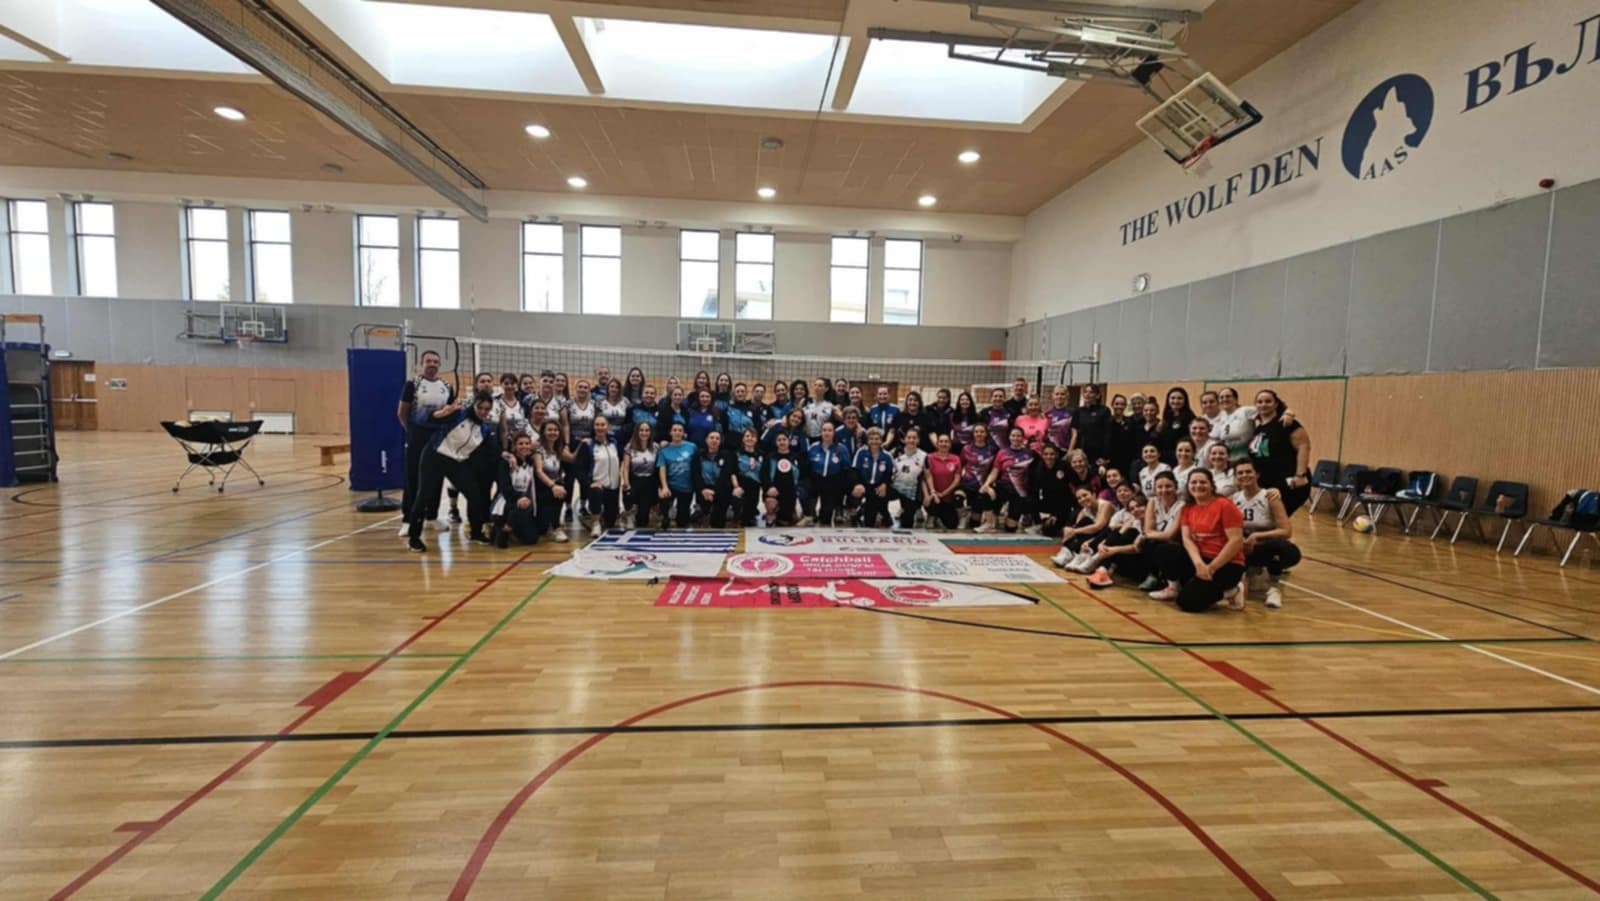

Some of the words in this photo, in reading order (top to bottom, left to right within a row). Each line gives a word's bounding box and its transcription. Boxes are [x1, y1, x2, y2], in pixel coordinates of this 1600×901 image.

[1362, 146, 1409, 181] AAS
[1119, 209, 1159, 246] THE
[1165, 173, 1242, 228] WOLF
[1248, 137, 1324, 198] DEN
[799, 555, 872, 564] Catchball
